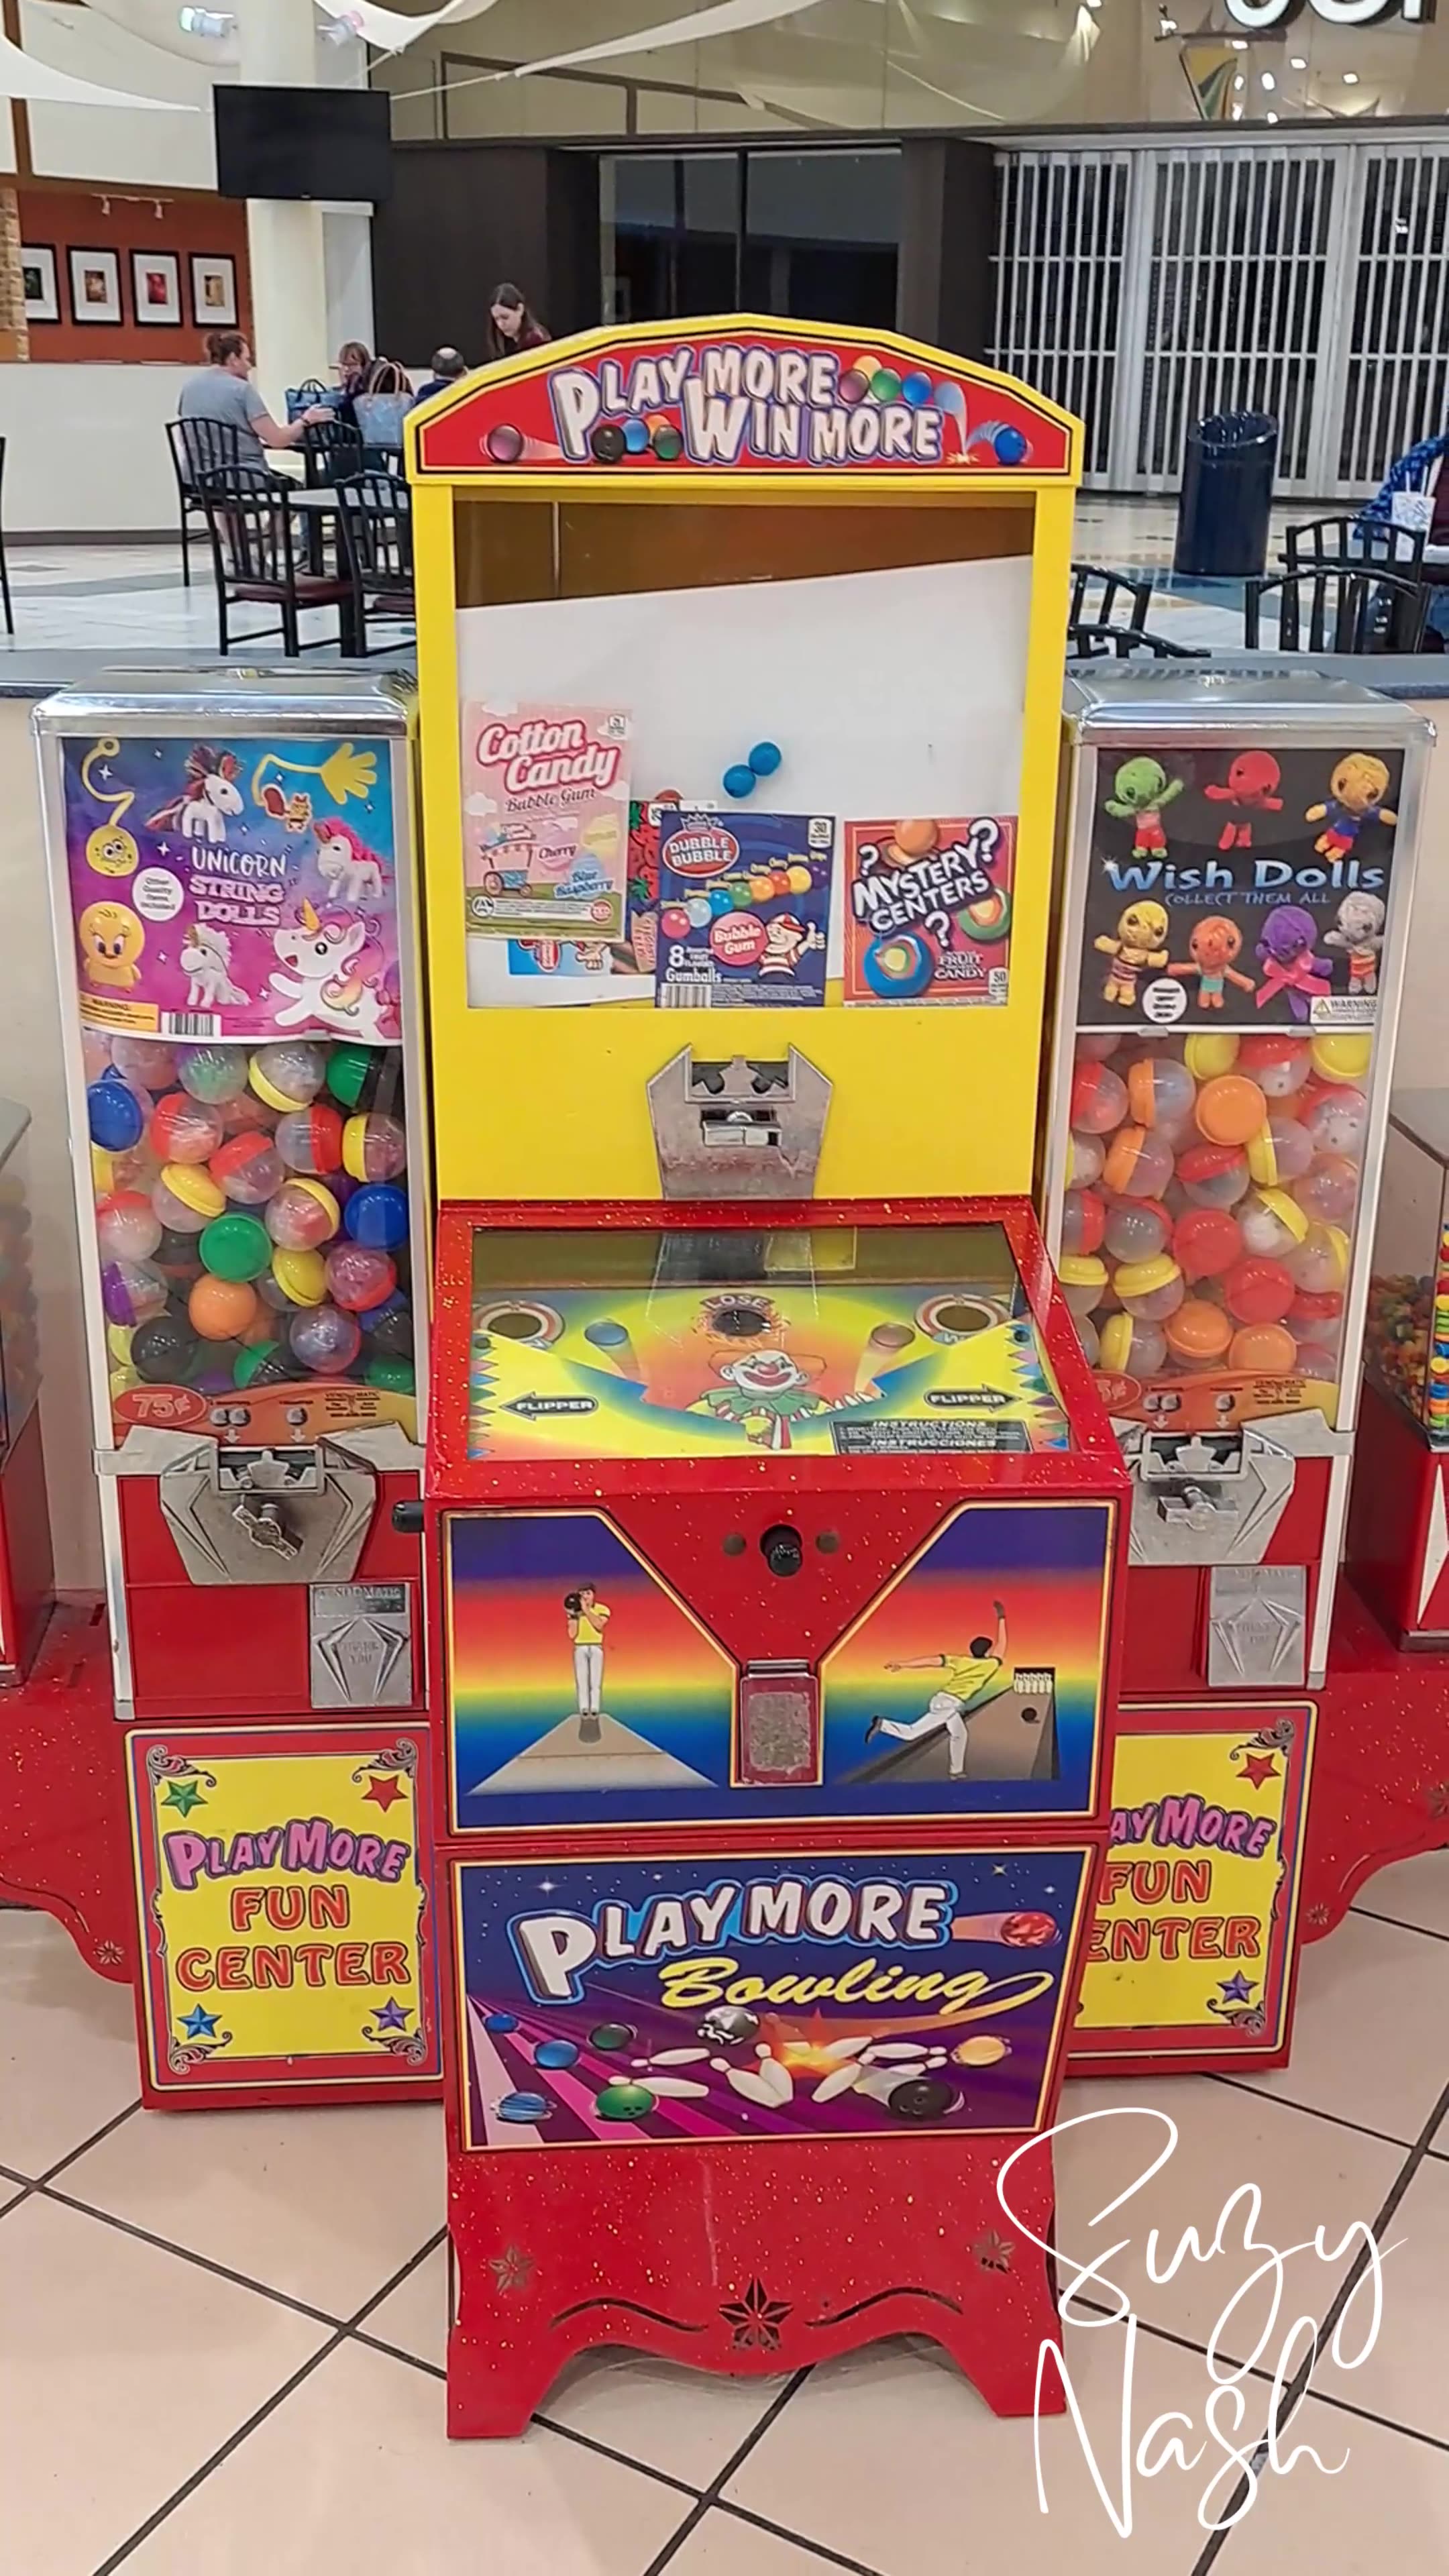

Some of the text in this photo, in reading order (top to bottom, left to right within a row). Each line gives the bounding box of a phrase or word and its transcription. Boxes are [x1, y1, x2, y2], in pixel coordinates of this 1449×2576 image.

[551, 345, 840, 462] PLAY MORE
[684, 376, 943, 463] WIN MORE
[477, 720, 586, 765] Cotton
[504, 743, 621, 794] Candy
[504, 787, 596, 812] Bubble Gum
[539, 844, 577, 859] Cherry
[669, 837, 731, 855] DUBBLE
[672, 850, 733, 867] BUBBLE
[853, 837, 980, 917] MYSTERY
[1109, 859, 1385, 892] Wish Dolls
[189, 875, 285, 904] STRING
[871, 871, 989, 931] CENTERS
[1165, 892, 1331, 907] COLLECT THEM ALL
[195, 900, 282, 926] DOLLS
[714, 923, 762, 945] Bubble
[669, 945, 684, 967] 8
[724, 941, 755, 955] Gum
[665, 967, 722, 983] Gumballs
[934, 967, 986, 979] CANDY
[704, 1295, 768, 1309] LOSE
[930, 1394, 1006, 1404] FLIPPER
[1095, 1378, 1128, 1402] 5¢
[132, 1393, 192, 1419] 75¢
[517, 1401, 592, 1410] FLIPPER
[1109, 1793, 1275, 1858] AYMORE
[231, 1886, 350, 1931] FUN
[1087, 1916, 1262, 1962] ENTER
[176, 1942, 411, 1991] CENTER
[659, 1957, 1055, 2010] Bowling
